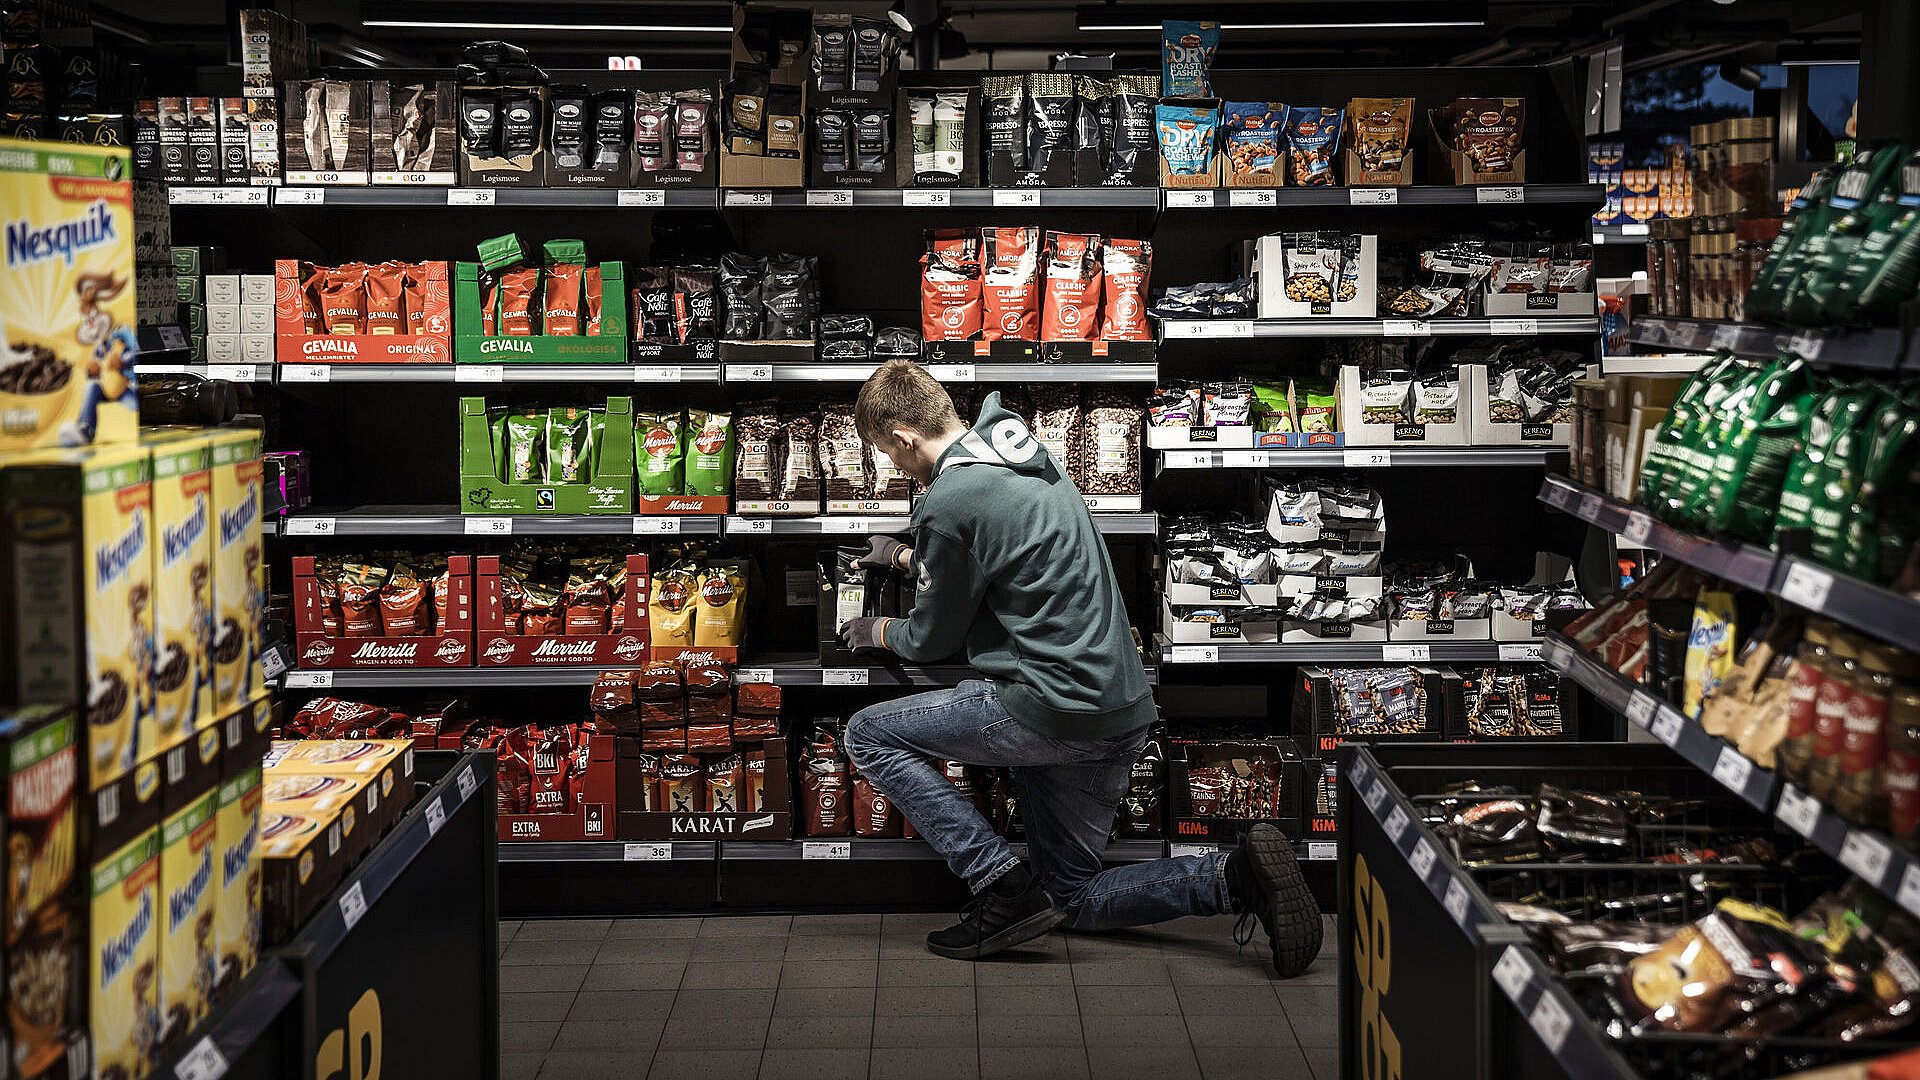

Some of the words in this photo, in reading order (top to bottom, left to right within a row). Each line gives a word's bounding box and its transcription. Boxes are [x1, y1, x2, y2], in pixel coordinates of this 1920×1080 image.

[1171, 46, 1208, 63] DRY
[832, 95, 870, 105] Løgismose
[1165, 128, 1204, 147] DRY
[316, 173, 338, 182] ØGO
[403, 173, 425, 182] ØGO
[483, 174, 520, 184] Løgismose
[569, 174, 606, 184] Løgismose
[655, 175, 692, 184] Løgismose
[836, 175, 873, 184] Løgismose
[1175, 174, 1208, 185] Nutisal
[1238, 174, 1271, 185] Nutisal
[212, 192, 223, 200] 14
[248, 192, 260, 200] 20
[304, 192, 316, 200] 31
[476, 193, 488, 201] 35
[645, 193, 658, 201] 35
[753, 193, 765, 202] 35
[834, 193, 847, 202] 35
[930, 194, 943, 202] 35
[1022, 194, 1034, 202] 34
[1194, 194, 1207, 203] 39
[1257, 193, 1270, 201] 38
[1378, 192, 1390, 200] 29
[1505, 191, 1518, 199] 38
[8, 203, 114, 266] Nesquik
[938, 284, 969, 292] CLASSIC
[996, 289, 1028, 297] CLASSIC
[691, 297, 713, 307] Café
[1528, 296, 1557, 306] SERENO
[327, 308, 359, 318] GEVALIA
[368, 311, 400, 321] GEVALIA
[546, 309, 577, 318] GEVALIA
[303, 341, 359, 355] GEVALIA
[388, 344, 437, 355] ORIGINAL
[480, 339, 533, 353] GEVALIA
[753, 369, 766, 377] 45
[1191, 427, 1216, 438] SERENO
[1396, 426, 1424, 437] SERENO
[1524, 426, 1552, 437] SERENO
[640, 434, 678, 449] Merrild
[745, 444, 767, 453] ØGO
[1194, 456, 1205, 464] 14
[664, 500, 704, 512] Merrild
[767, 502, 790, 512] ØGO
[315, 522, 328, 530] 49
[492, 522, 505, 530] 55
[661, 521, 674, 529] 33
[752, 521, 765, 529] 59
[1317, 579, 1344, 589] SERENO
[699, 584, 734, 597] Merrild
[1212, 588, 1239, 597] SERENO
[841, 591, 861, 602] KEN
[1212, 625, 1239, 635] SERENO
[1322, 625, 1349, 635] SERENO
[303, 645, 335, 659] Merrild
[351, 642, 417, 657] Merrild
[434, 644, 466, 658] Merrild
[483, 644, 515, 658] Merrild
[531, 640, 597, 656] Merrild
[613, 641, 645, 655] Merrild
[1411, 649, 1422, 657] 11
[1527, 648, 1539, 657] 20
[676, 650, 713, 662] Merrild
[313, 676, 326, 684] 36
[753, 673, 766, 682] 37
[849, 673, 862, 681] 37
[536, 752, 556, 768] BKI
[707, 760, 738, 773] KARAT
[1133, 763, 1153, 771] Café
[1132, 769, 1154, 778] Siesta
[535, 792, 564, 803] EXTRA
[512, 822, 541, 834] EXTRA
[587, 820, 601, 833] BKI
[672, 816, 737, 834] KARAT
[1178, 822, 1209, 835] KiMs
[652, 847, 665, 857] 36
[830, 846, 843, 856] 41
